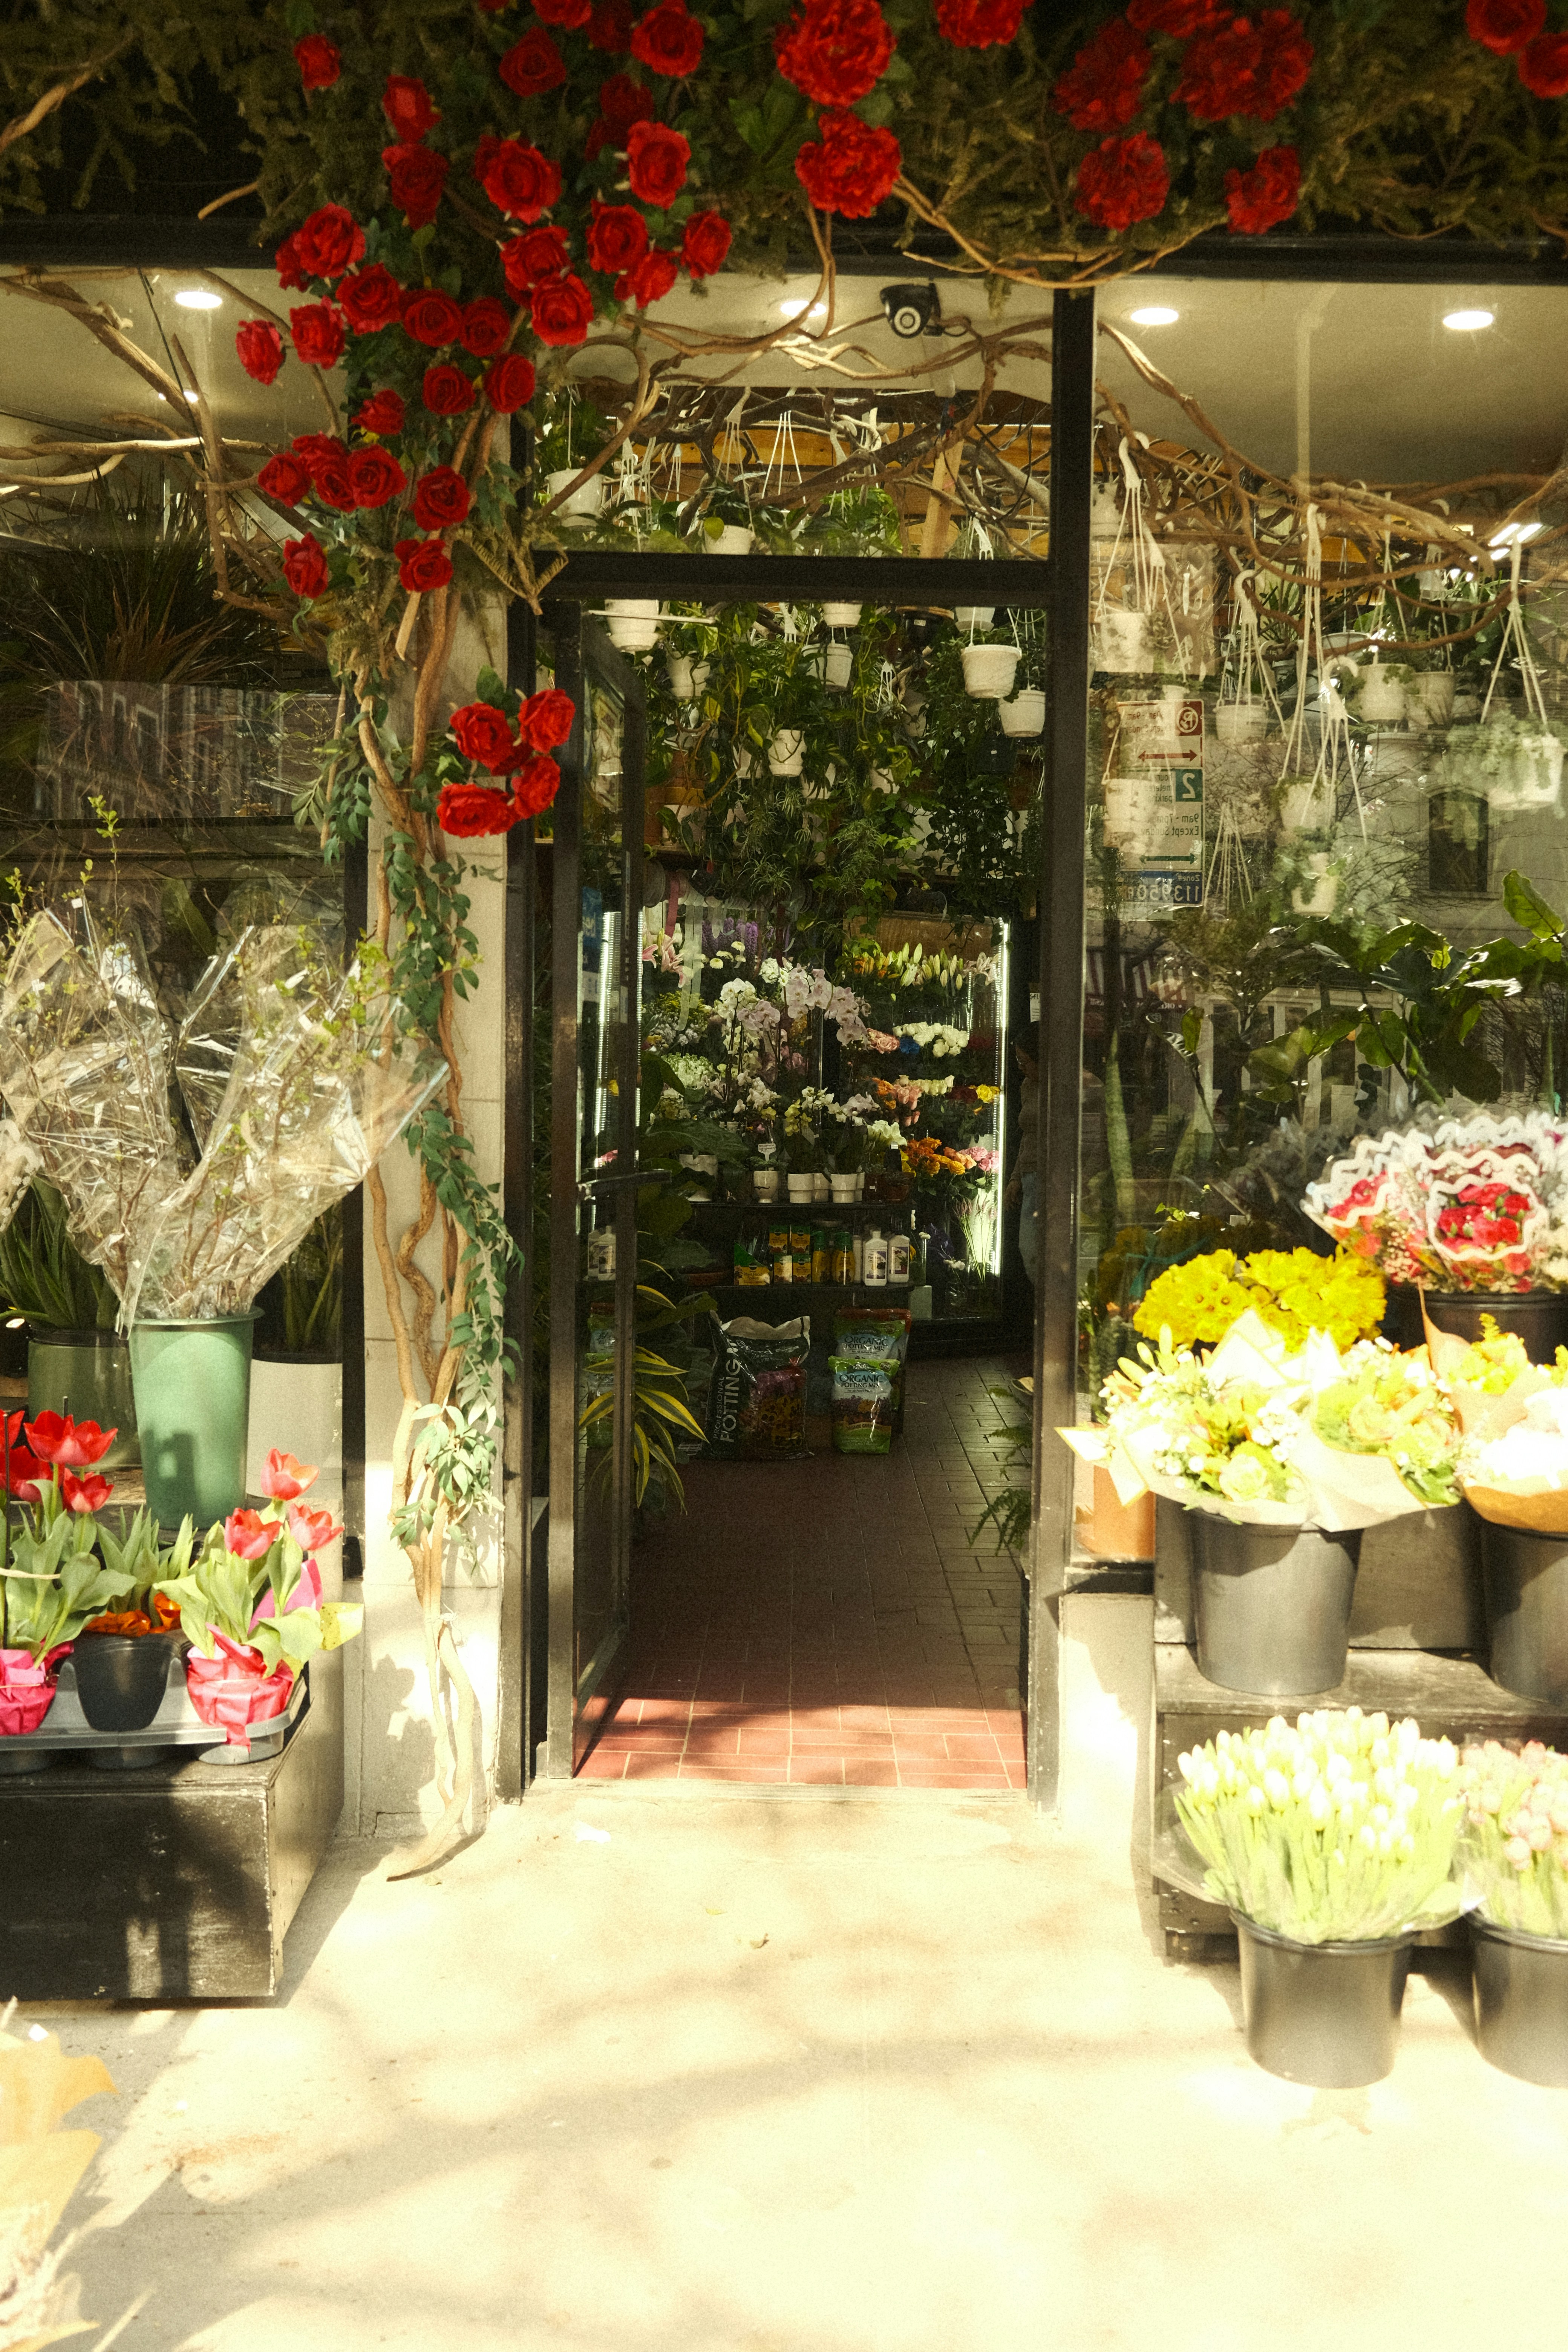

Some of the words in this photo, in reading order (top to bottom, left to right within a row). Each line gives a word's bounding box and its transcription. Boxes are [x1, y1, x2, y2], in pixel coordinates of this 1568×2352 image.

[845, 1336, 888, 1346] ORGANIC
[839, 1374, 884, 1383] ORGANIC
[720, 1358, 741, 1443] POTTING
